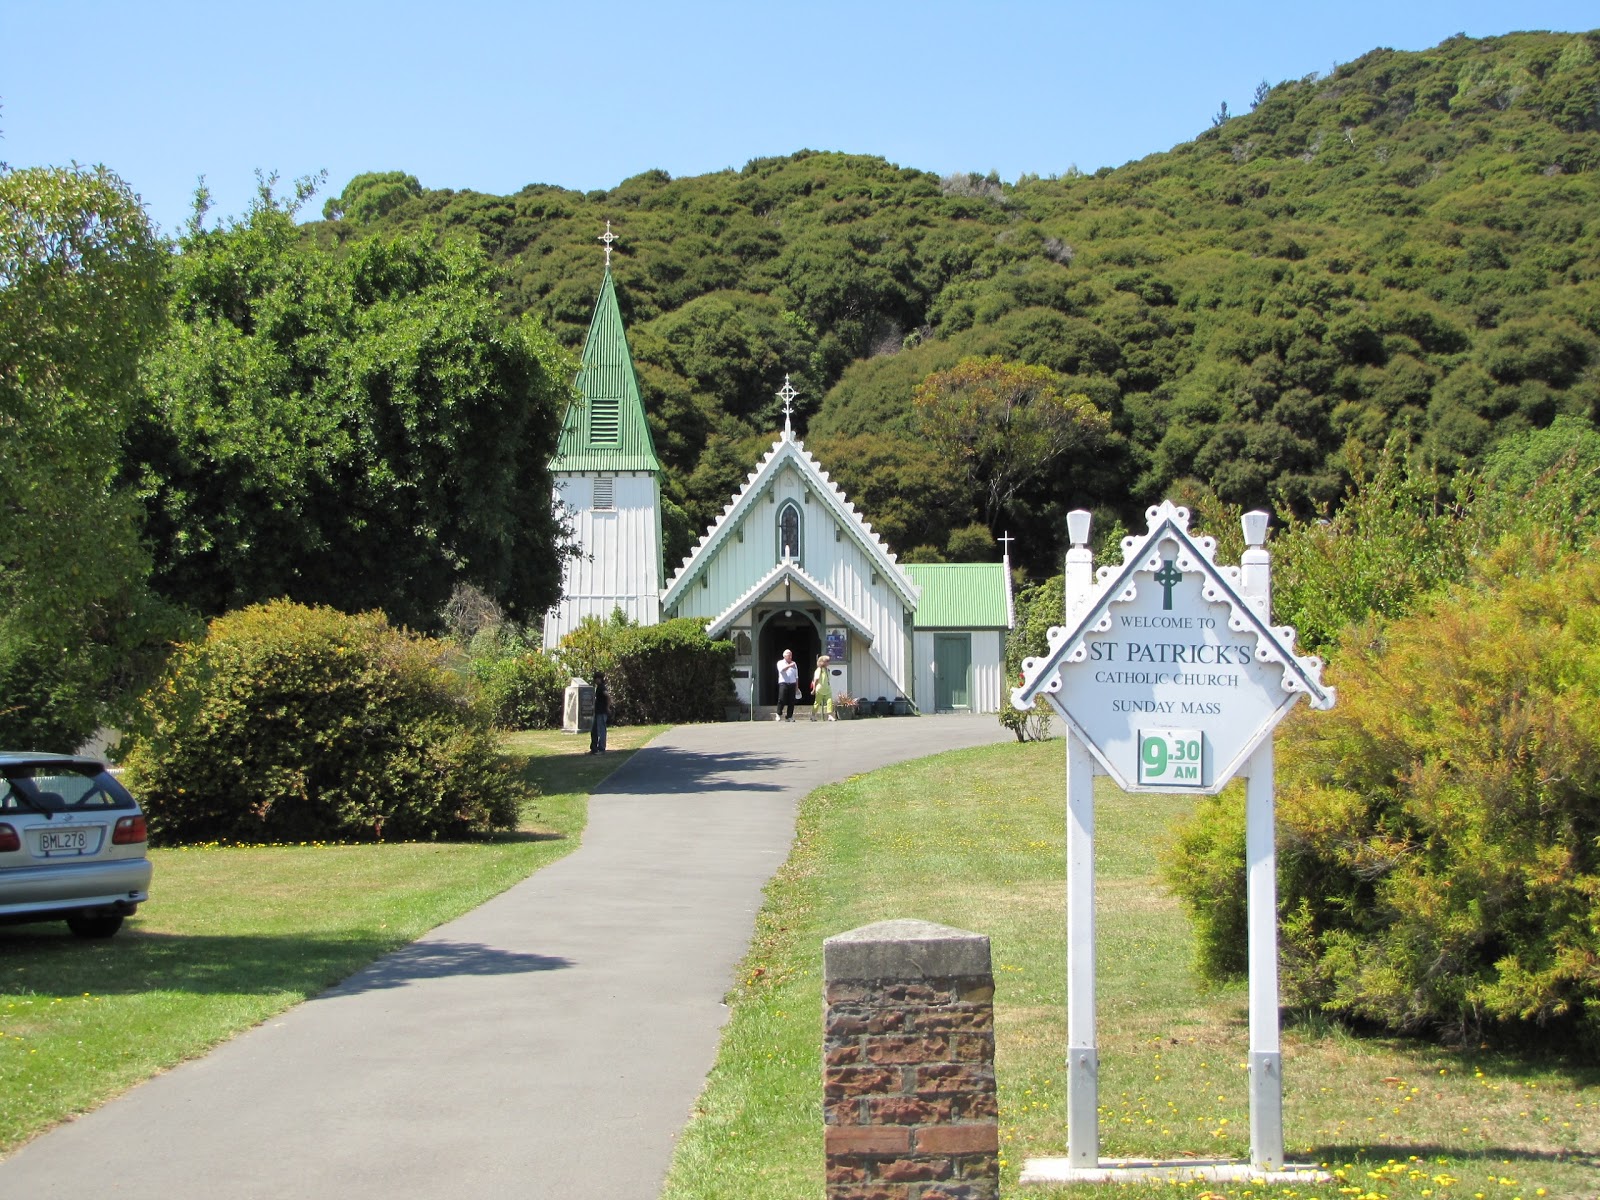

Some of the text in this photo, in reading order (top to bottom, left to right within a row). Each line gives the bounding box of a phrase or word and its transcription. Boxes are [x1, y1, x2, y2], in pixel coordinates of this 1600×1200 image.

[1120, 616, 1216, 630] WELCOME TO
[1090, 641, 1251, 665] ST PATRICK'S
[1095, 671, 1239, 687] CATHOLIC CHURCH
[1112, 699, 1221, 715] SUNDAY MASS
[1174, 766, 1198, 779] AM
[42, 833, 86, 849] BML278
